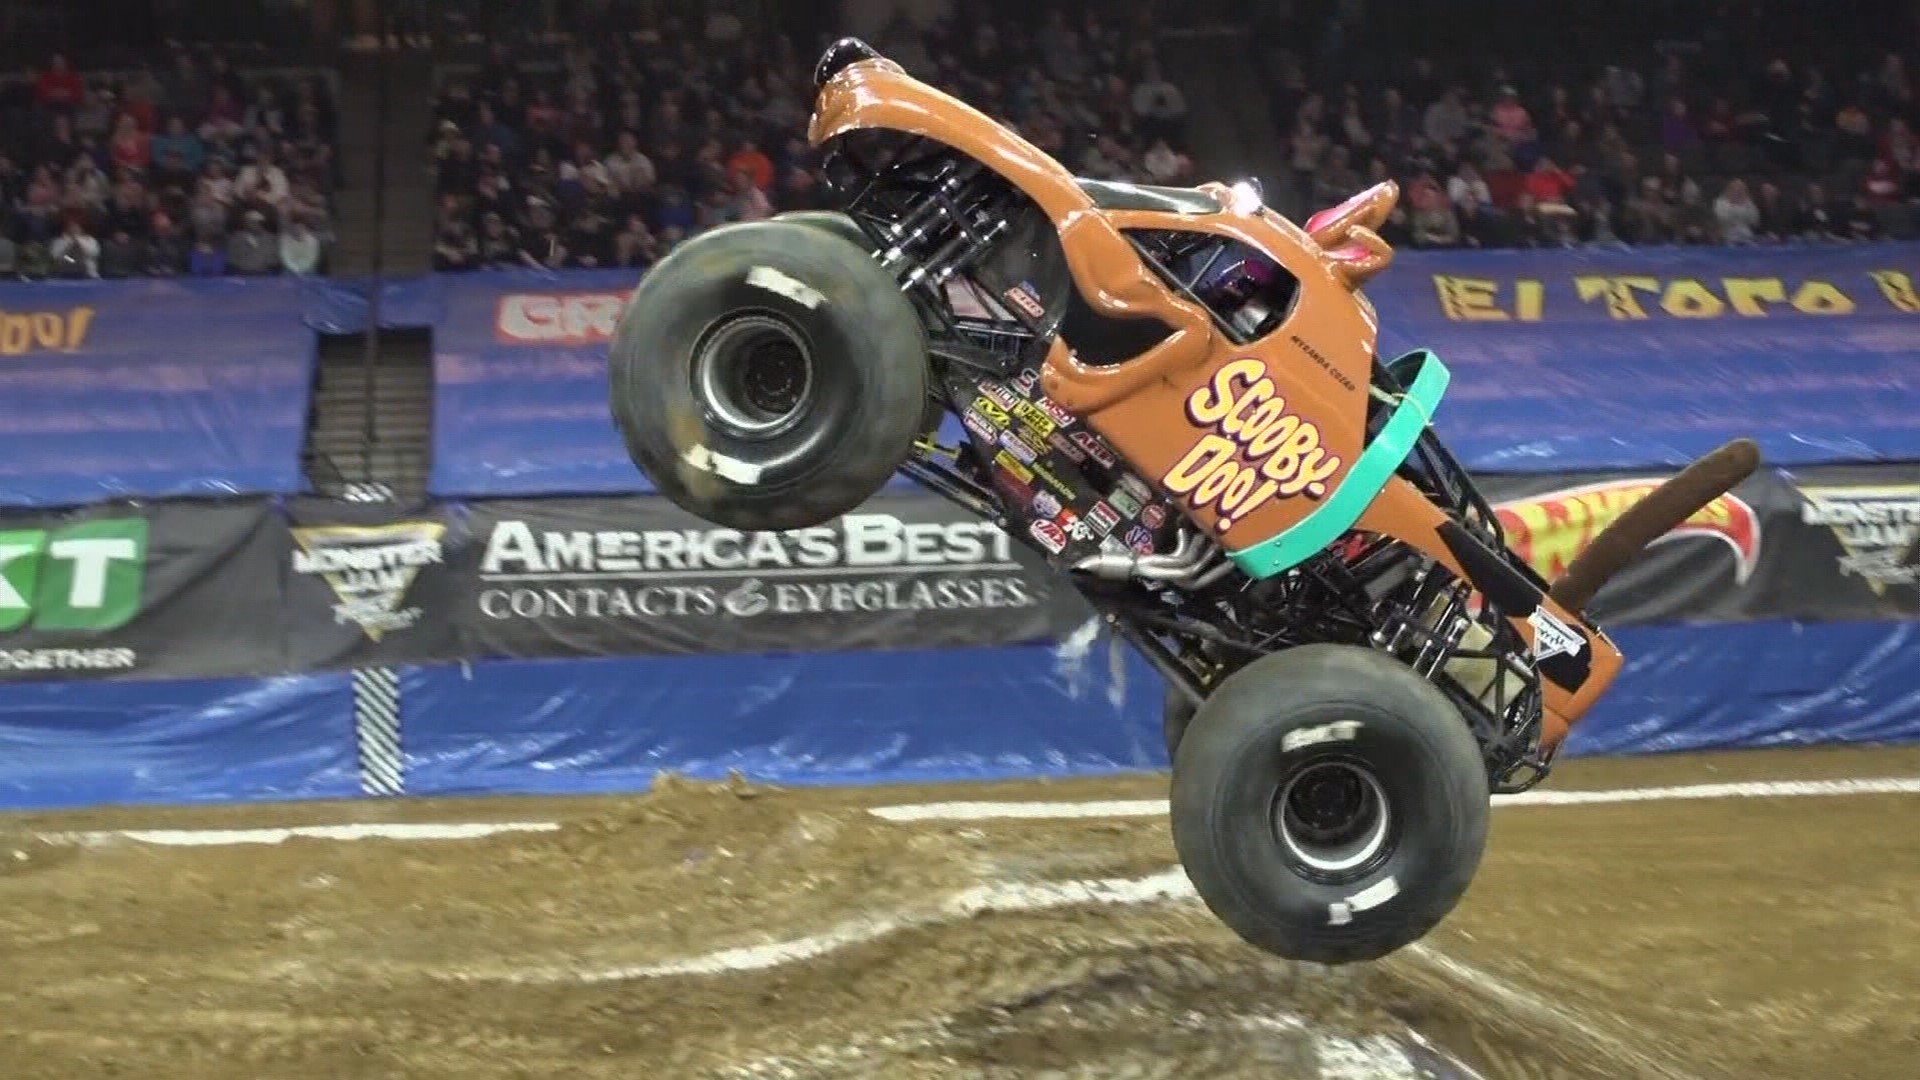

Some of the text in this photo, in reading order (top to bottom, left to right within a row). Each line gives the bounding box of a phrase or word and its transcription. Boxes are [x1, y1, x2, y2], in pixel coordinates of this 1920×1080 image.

[479, 513, 1011, 572] AMERICA'S BEST
[478, 577, 1035, 619] CONTACTS & EYEGLASSES
